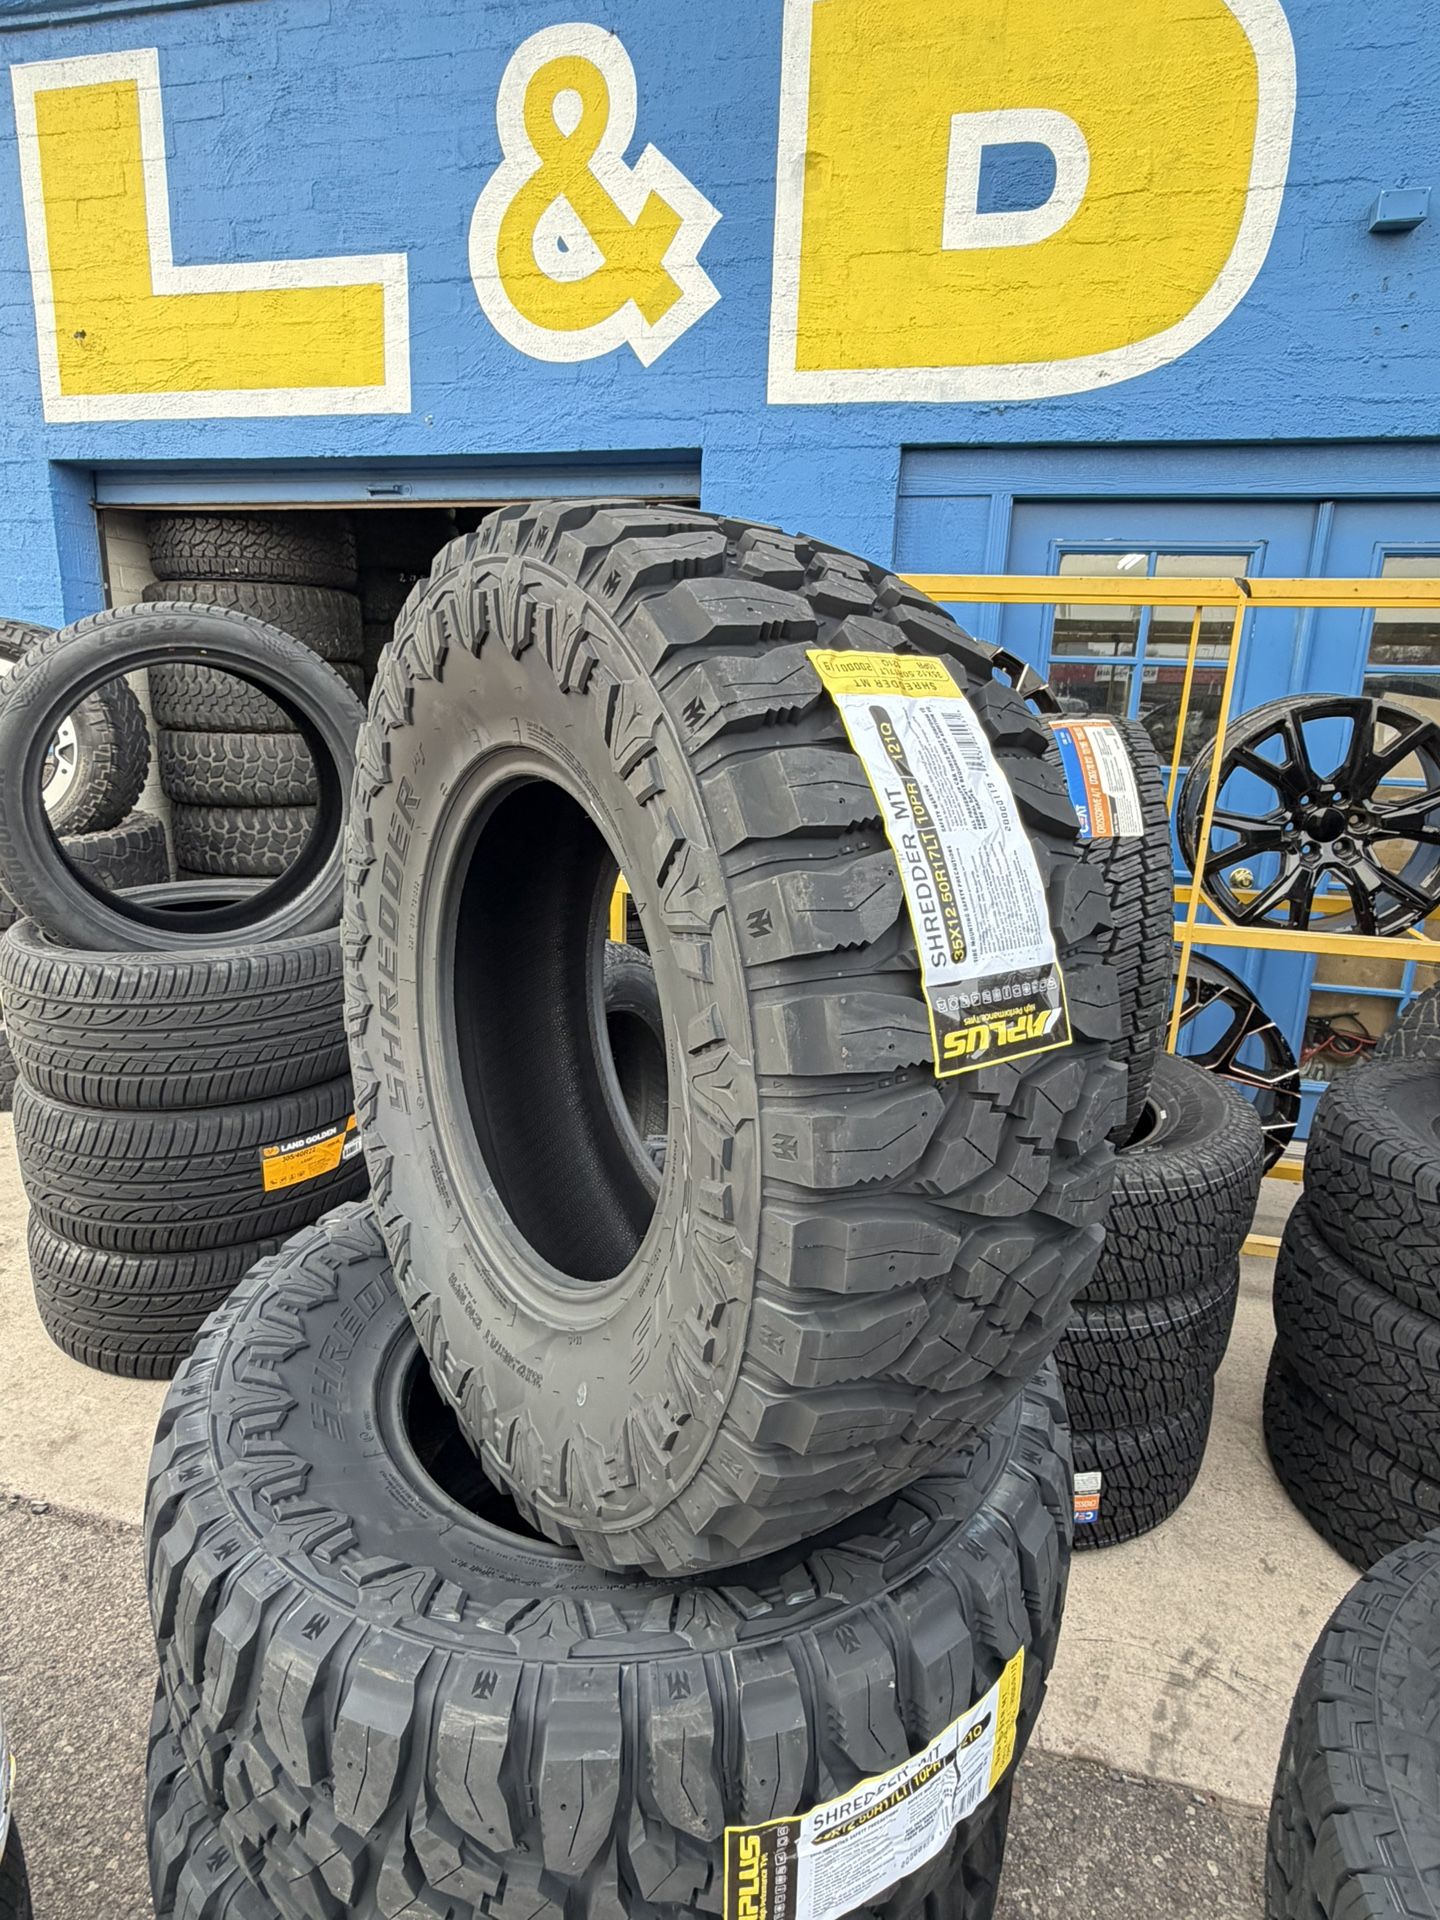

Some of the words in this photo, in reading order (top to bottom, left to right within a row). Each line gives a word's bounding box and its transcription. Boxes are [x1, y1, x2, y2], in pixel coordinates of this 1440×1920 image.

[10, 48, 411, 422] L
[469, 21, 722, 367] &
[766, 0, 1296, 405] D
[100, 618, 199, 643] LGS87
[855, 679, 872, 687] MT
[876, 678, 937, 691] SHREDDER
[880, 722, 905, 762] 121Q
[885, 787, 910, 820] MT
[906, 783, 929, 824] 10PR
[902, 834, 947, 967] SHREDDER
[921, 831, 965, 961] 35X12.50R17LT
[377, 774, 421, 1115] SHREDDER
[281, 1139, 304, 1152] LAND
[306, 1127, 337, 1144] GOLDEN
